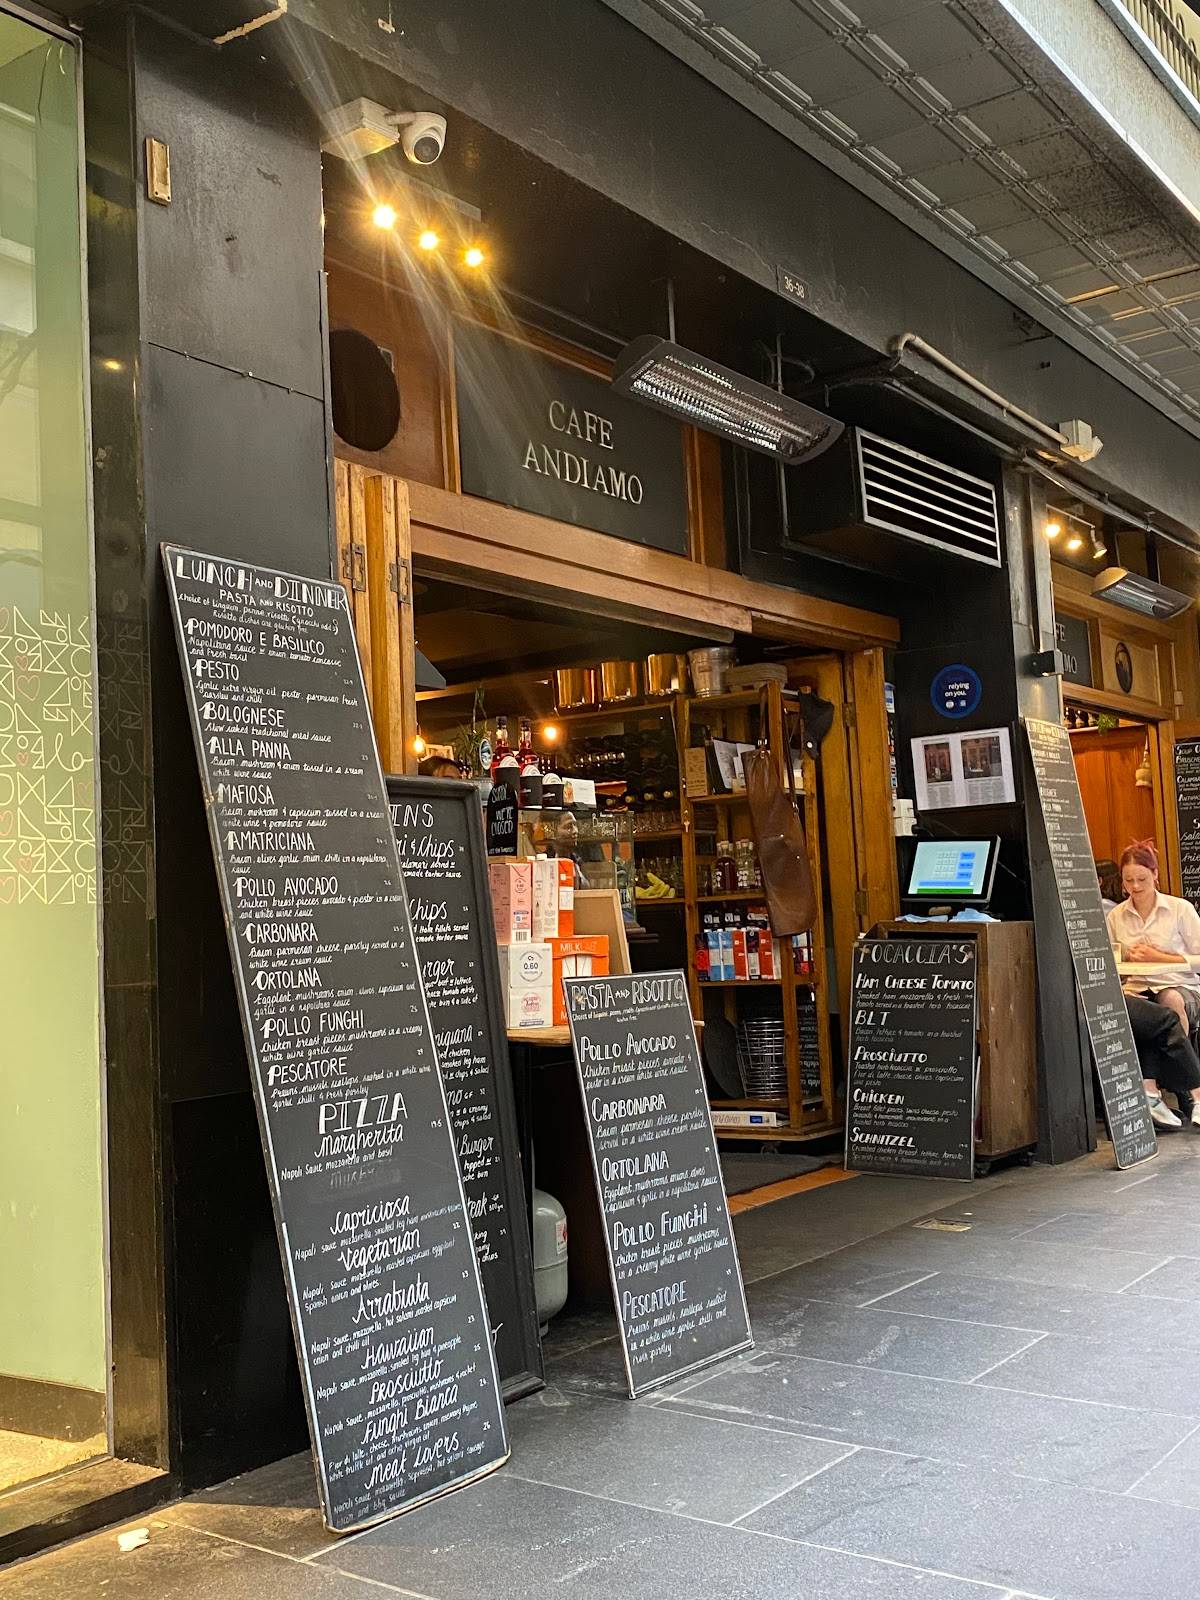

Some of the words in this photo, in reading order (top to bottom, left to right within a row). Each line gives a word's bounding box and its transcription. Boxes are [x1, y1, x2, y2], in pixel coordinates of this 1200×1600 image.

[784, 276, 805, 298] 36-38
[549, 400, 614, 450] CAFE
[522, 439, 643, 504] ANDIAMO
[175, 555, 252, 592] LUNCH
[254, 577, 273, 589] AND
[274, 576, 347, 611] DINNER
[219, 589, 257, 607] PASTA
[259, 599, 274, 607] AND
[275, 601, 314, 618] RISOTTO
[184, 617, 253, 644] POMODORO
[259, 632, 267, 646] E
[272, 634, 325, 656] BASILICO
[192, 658, 240, 681] PESTO
[1063, 653, 1077, 674] MO
[221, 683, 239, 694] extra
[241, 684, 264, 697] virgin
[266, 686, 276, 696] oil
[306, 693, 339, 704] parmesan
[948, 682, 970, 690] relying
[198, 701, 285, 728] BOLOGNESE
[206, 736, 245, 757] ALLA
[252, 739, 292, 761] PANNA
[215, 782, 275, 805] MAFIOSA
[491, 820, 513, 836] CLOSED
[223, 831, 315, 851] AMATRICIANA
[417, 834, 455, 866] Chips
[232, 876, 276, 898] POLLO
[283, 876, 338, 897] AVOCADO
[254, 907, 275, 919] white
[276, 908, 293, 918] wine
[293, 907, 314, 917] sauce
[272, 897, 294, 908] breast
[296, 898, 319, 910] pieces
[352, 895, 374, 907] pesto
[409, 898, 447, 927] Chips
[240, 922, 318, 944] CARBONARA
[276, 945, 313, 959] parmesan
[315, 943, 339, 954] cheese
[343, 939, 370, 953] parsley
[859, 944, 971, 964] FOCACCIA'S
[249, 958, 269, 969] white
[314, 955, 333, 964] sauce
[251, 967, 323, 991] ORTOLANA
[855, 972, 879, 989] HAM
[884, 974, 928, 989] CHEESE
[931, 974, 974, 990] TOMATO
[253, 992, 292, 1006] Eggplant
[295, 988, 334, 1000] mushrooms
[571, 983, 616, 1012] PASTA
[615, 988, 631, 998] AND
[631, 978, 683, 1005] RISOTTO
[942, 992, 960, 1001] fresh
[253, 1005, 278, 1021] garlic
[260, 1015, 311, 1039] POLLO
[319, 1009, 365, 1032] FUNGHI
[855, 1009, 891, 1026] BLT
[260, 1038, 292, 1053] Chicken
[295, 1033, 321, 1047] breast
[323, 1033, 346, 1048] pieces
[348, 1029, 387, 1041] mushrooms
[402, 1023, 423, 1038] creamy
[580, 1035, 621, 1063] POLLO
[626, 1032, 677, 1056] AVOCADO
[261, 1051, 284, 1063] white
[307, 1045, 331, 1062] garlic
[332, 1045, 354, 1053] sauce
[853, 1045, 928, 1063] PROSCIUTTO
[266, 1056, 348, 1086] PESCATORE
[612, 1062, 636, 1074] breast
[637, 1060, 660, 1073] pieces
[636, 1072, 653, 1084] white
[654, 1066, 669, 1077] wine
[669, 1065, 689, 1075] sauce
[272, 1099, 293, 1112] garlic
[297, 1093, 316, 1106] chilli
[344, 1085, 369, 1101] parsley
[591, 1093, 667, 1122] CARBONARA
[853, 1087, 905, 1105] CHICKEN
[318, 1092, 408, 1135] PIZZA
[620, 1120, 654, 1136] parmesan
[656, 1114, 679, 1127] cheese
[680, 1106, 705, 1122] parsley
[458, 1134, 495, 1158] Burger
[850, 1126, 916, 1148] SCHNITZEL
[281, 1167, 303, 1181] Napoli
[363, 1150, 376, 1162] and
[377, 1147, 393, 1160] basil
[464, 1157, 485, 1171] topped
[601, 1150, 670, 1182] ORTOLANA
[898, 1148, 918, 1157] breast
[942, 1151, 964, 1160] tomato
[329, 1194, 411, 1238] Capriciosa
[294, 1243, 317, 1261] Napoli
[340, 1231, 372, 1247] mozzarella
[374, 1223, 395, 1236] smoked
[396, 1221, 406, 1232] leg
[613, 1220, 655, 1251] POLLO
[337, 1228, 421, 1276] Vegetarian
[302, 1284, 324, 1300] Napoli
[350, 1285, 362, 1296] and
[352, 1272, 430, 1324] Arrabiata
[622, 1279, 688, 1323] PESCATORE
[311, 1337, 331, 1355] Napoli
[385, 1317, 395, 1327] hot
[395, 1311, 414, 1324] salami
[434, 1293, 457, 1310] capsicum
[332, 1348, 343, 1358] and
[360, 1326, 434, 1370] Hawaiian
[316, 1385, 339, 1400] Napoli
[360, 1365, 388, 1385] mozzarella
[391, 1352, 410, 1371] smoked
[411, 1351, 420, 1366] leg
[323, 1423, 344, 1438] Napoli
[367, 1398, 399, 1420] mozzarella
[401, 1385, 428, 1405] prosciutto
[429, 1374, 455, 1395] mushrooms
[459, 1362, 476, 1378] rocket
[360, 1404, 409, 1445] Funghi
[414, 1383, 459, 1422] Bianca
[369, 1440, 388, 1454] cheese
[391, 1423, 422, 1444] mushrooms
[376, 1448, 386, 1462] and
[404, 1435, 420, 1452] virgin
[357, 1506, 372, 1519] and
[373, 1499, 386, 1514] bbq
